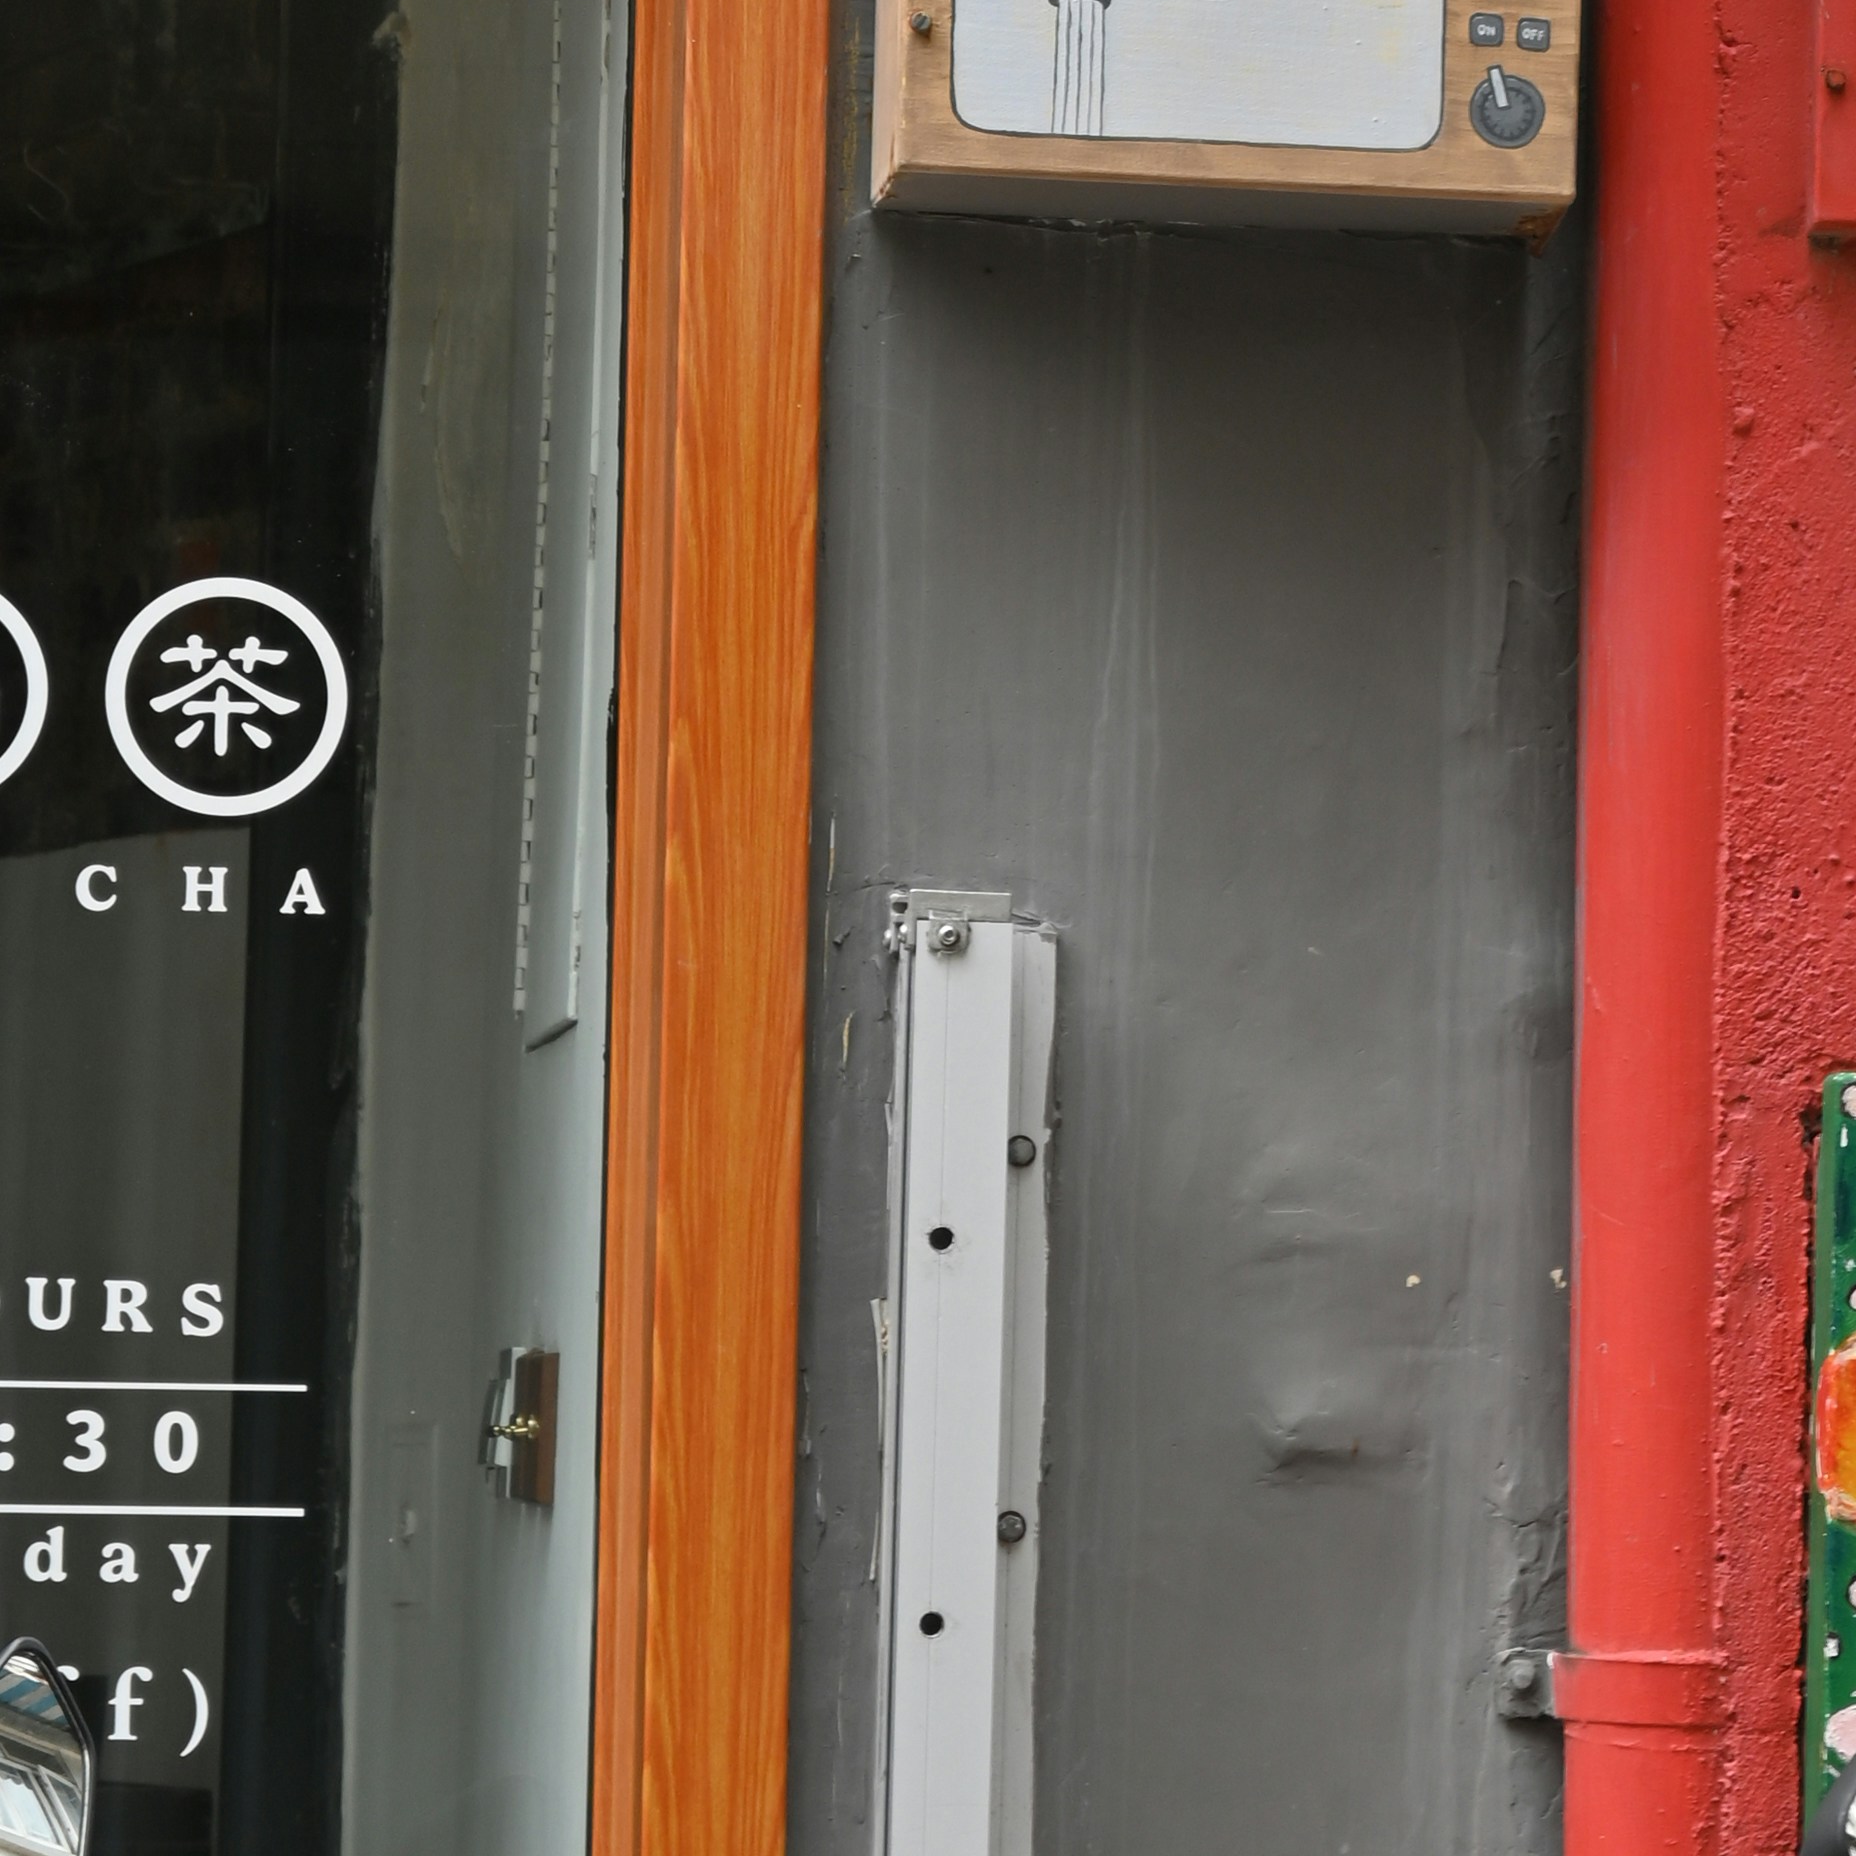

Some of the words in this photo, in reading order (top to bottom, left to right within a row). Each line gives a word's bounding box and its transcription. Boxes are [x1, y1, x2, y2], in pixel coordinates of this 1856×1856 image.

[1522, 28, 1545, 40] OFF
[150, 634, 300, 756] 茶
[75, 864, 326, 915] CHA
